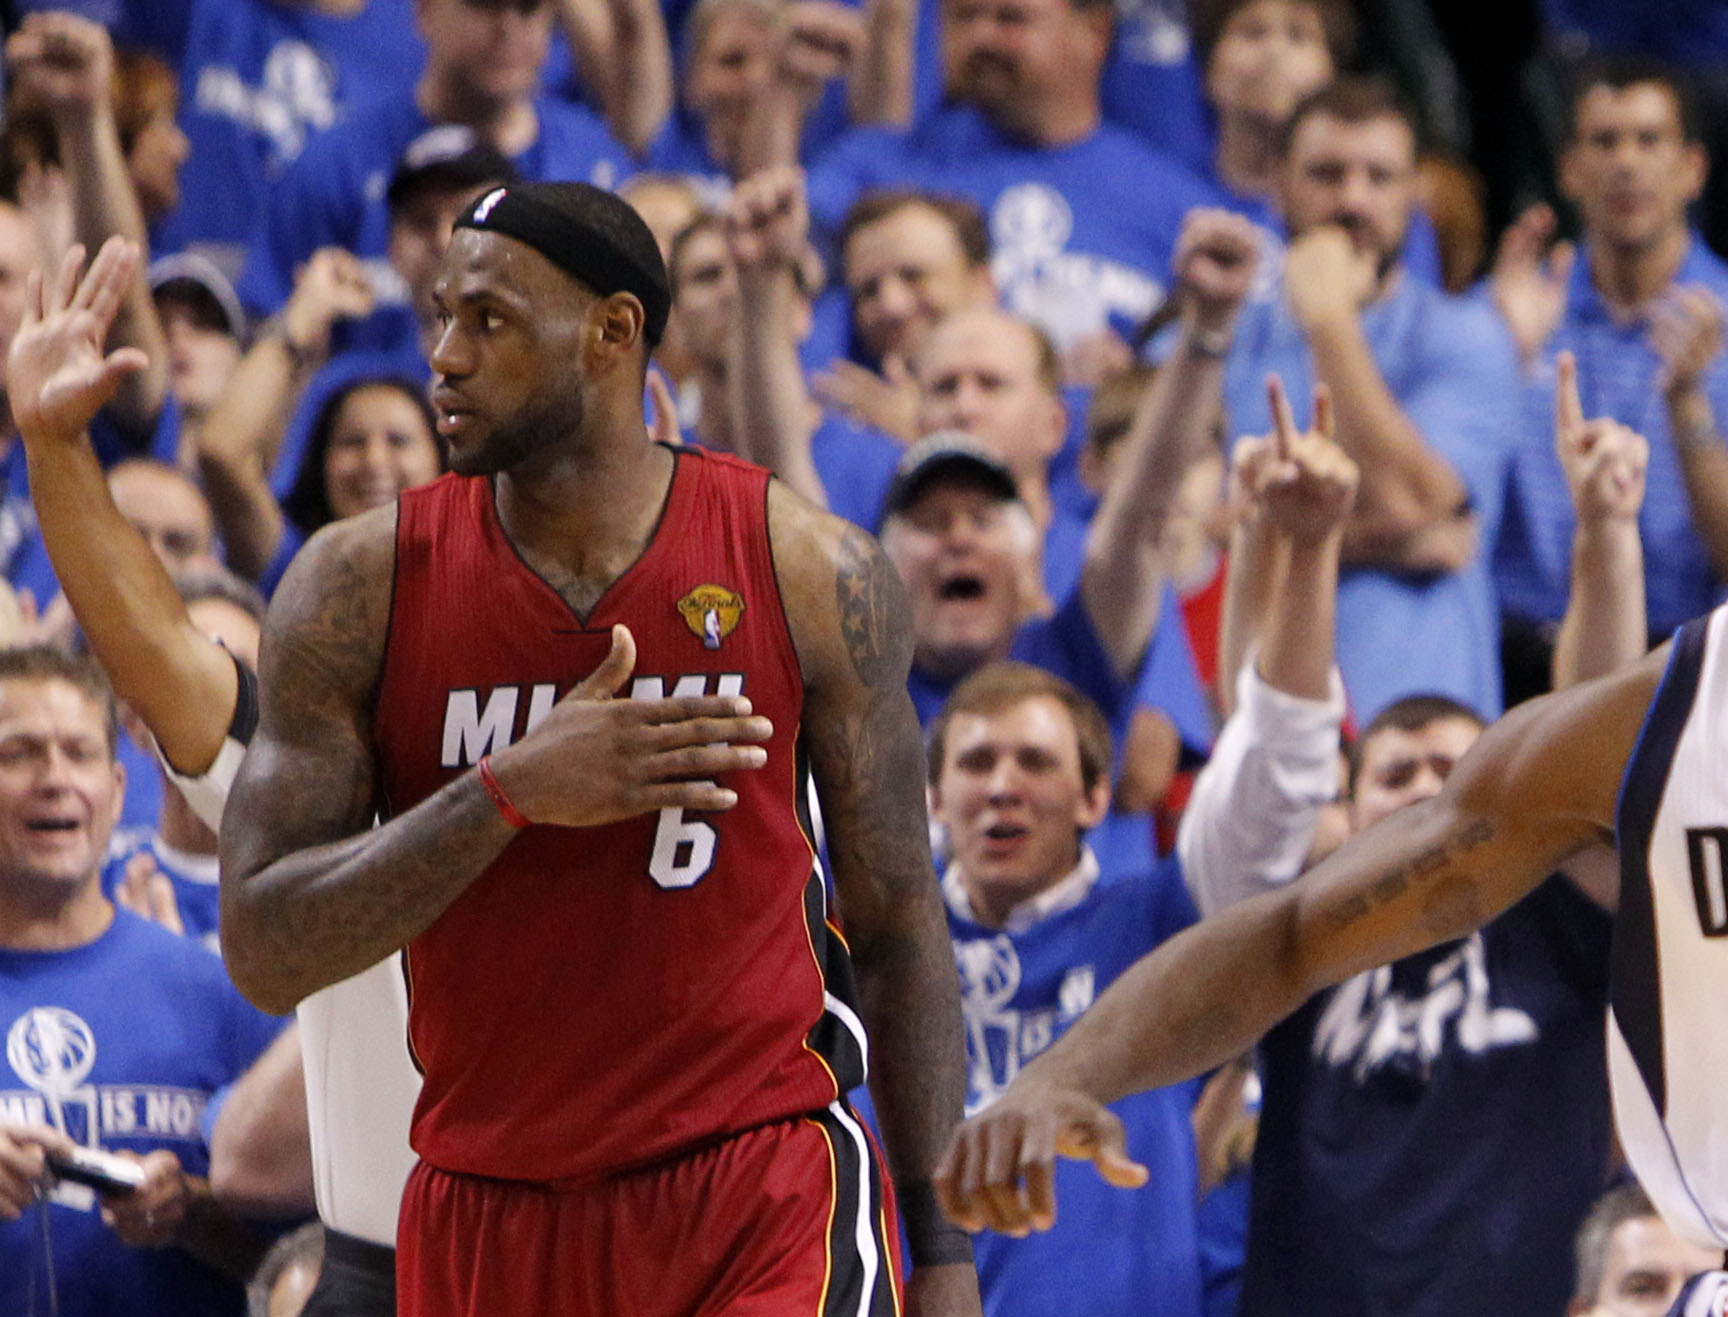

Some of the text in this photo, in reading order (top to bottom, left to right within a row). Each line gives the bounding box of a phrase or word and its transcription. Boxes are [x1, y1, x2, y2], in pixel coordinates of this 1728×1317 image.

[648, 780, 719, 889] 6
[101, 1089, 137, 1134] IS
[146, 1090, 206, 1137] NO
